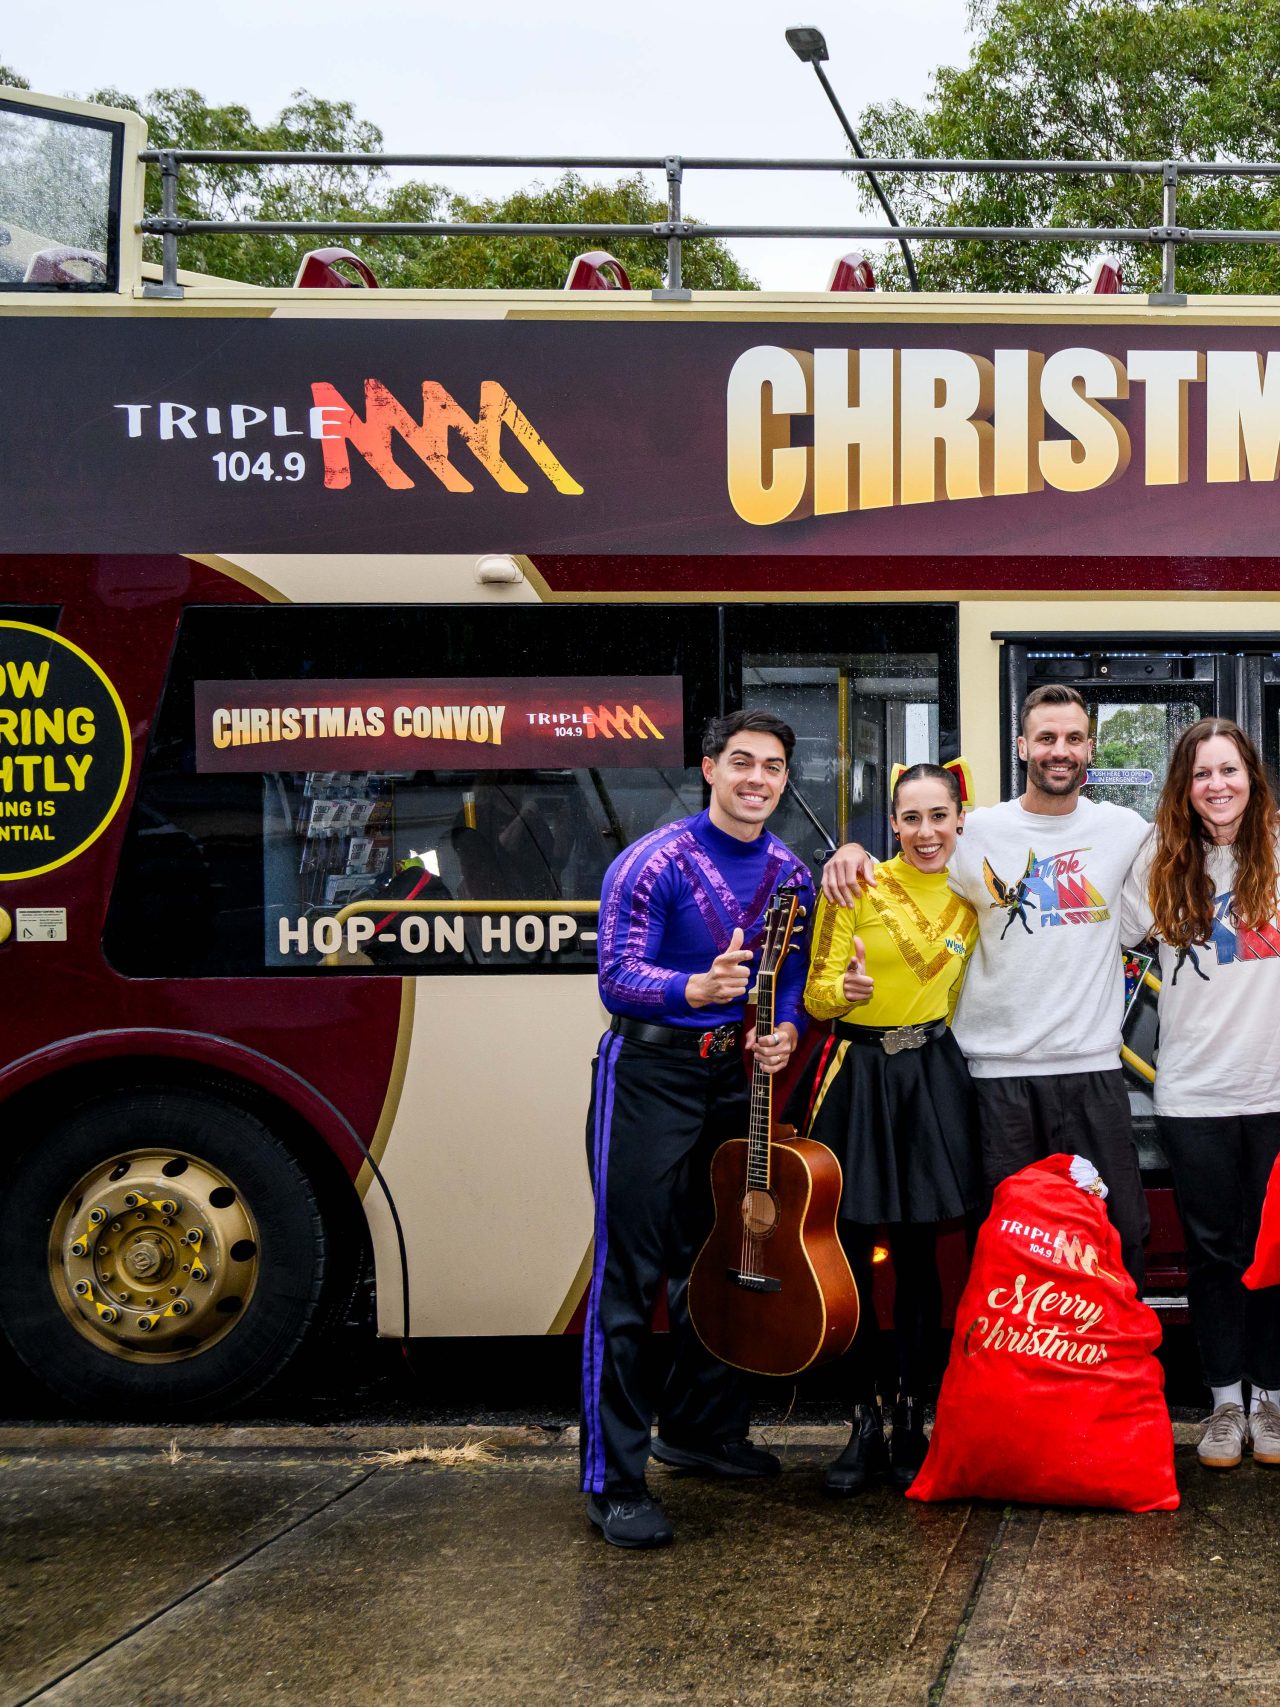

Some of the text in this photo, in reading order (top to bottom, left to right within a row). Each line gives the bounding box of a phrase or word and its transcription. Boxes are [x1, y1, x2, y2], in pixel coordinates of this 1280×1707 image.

[113, 401, 346, 440] TRIPLE
[212, 451, 306, 482] 104.9
[212, 706, 386, 749] CHRISTMAS
[393, 705, 506, 746] CONVOY
[525, 712, 593, 725] TRIPLE
[554, 727, 583, 737] 104.9
[37, 800, 56, 816] IS
[278, 915, 465, 954] HOP-ON
[1001, 1219, 1065, 1250] TRIPLE
[1029, 1243, 1053, 1258] 104.9
[987, 1273, 1105, 1334] Merry
[963, 1316, 1108, 1365] Christmas
